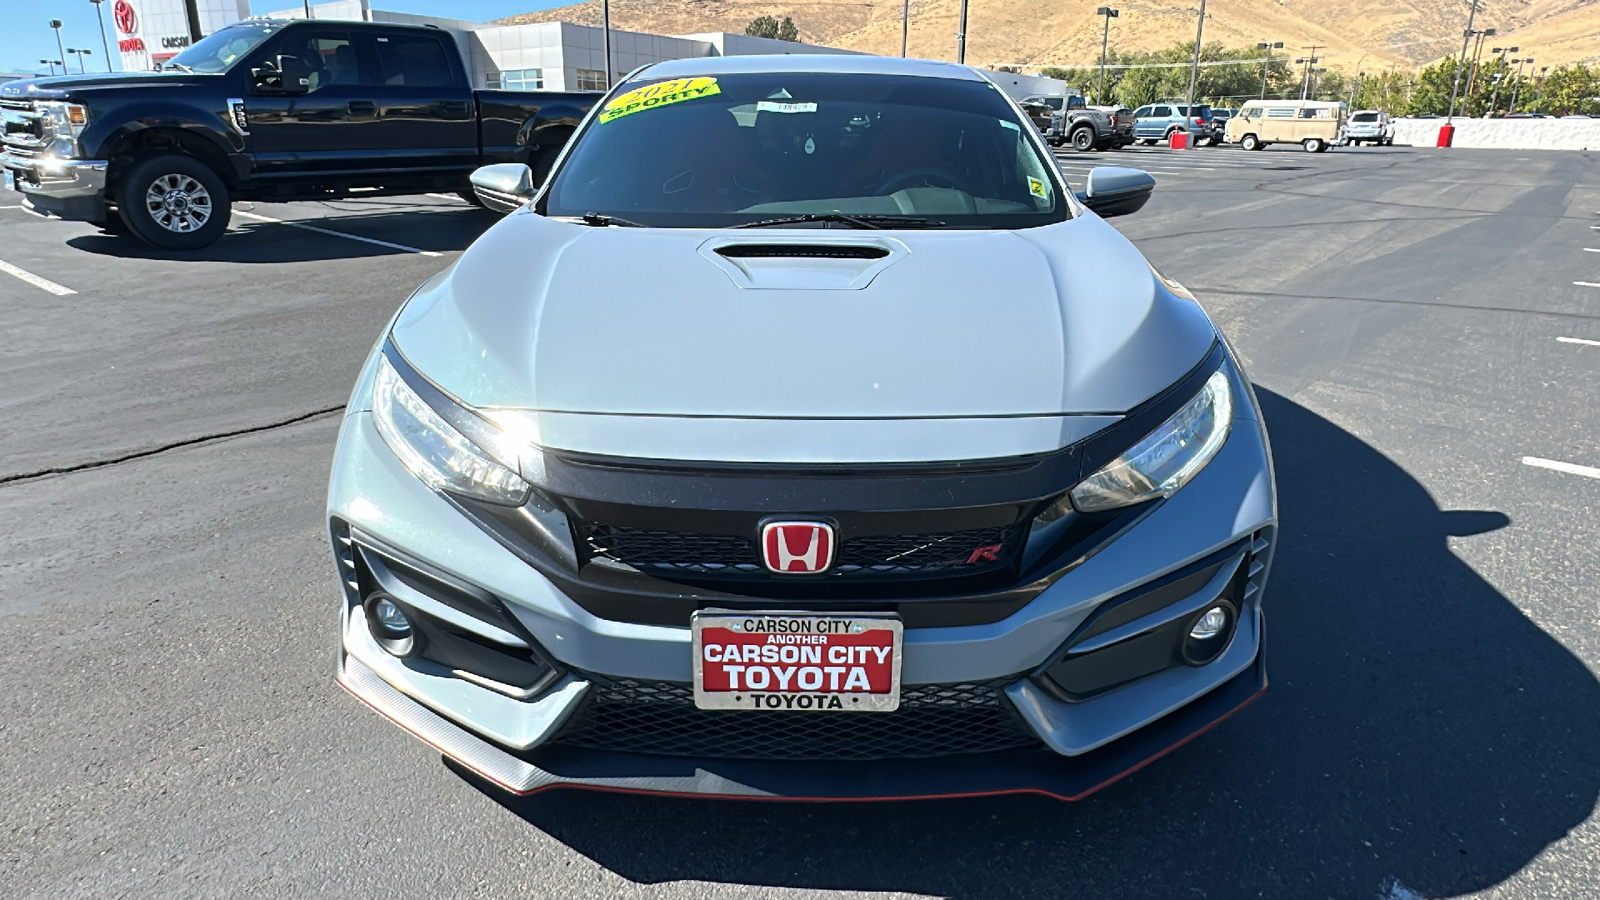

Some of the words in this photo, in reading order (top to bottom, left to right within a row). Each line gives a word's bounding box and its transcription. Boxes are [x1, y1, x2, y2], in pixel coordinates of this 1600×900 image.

[118, 38, 144, 53] TOYOTA
[608, 86, 711, 119] SPORTY
[624, 80, 694, 104] 2021
[966, 543, 1003, 565] R
[743, 619, 812, 633] CARSON
[816, 620, 853, 634] CITY
[766, 634, 828, 645] ANOTHER
[703, 643, 822, 664] CARSON
[828, 645, 892, 665] CITY
[722, 664, 871, 691] TOYOTA
[750, 694, 844, 709] TOYOTA
